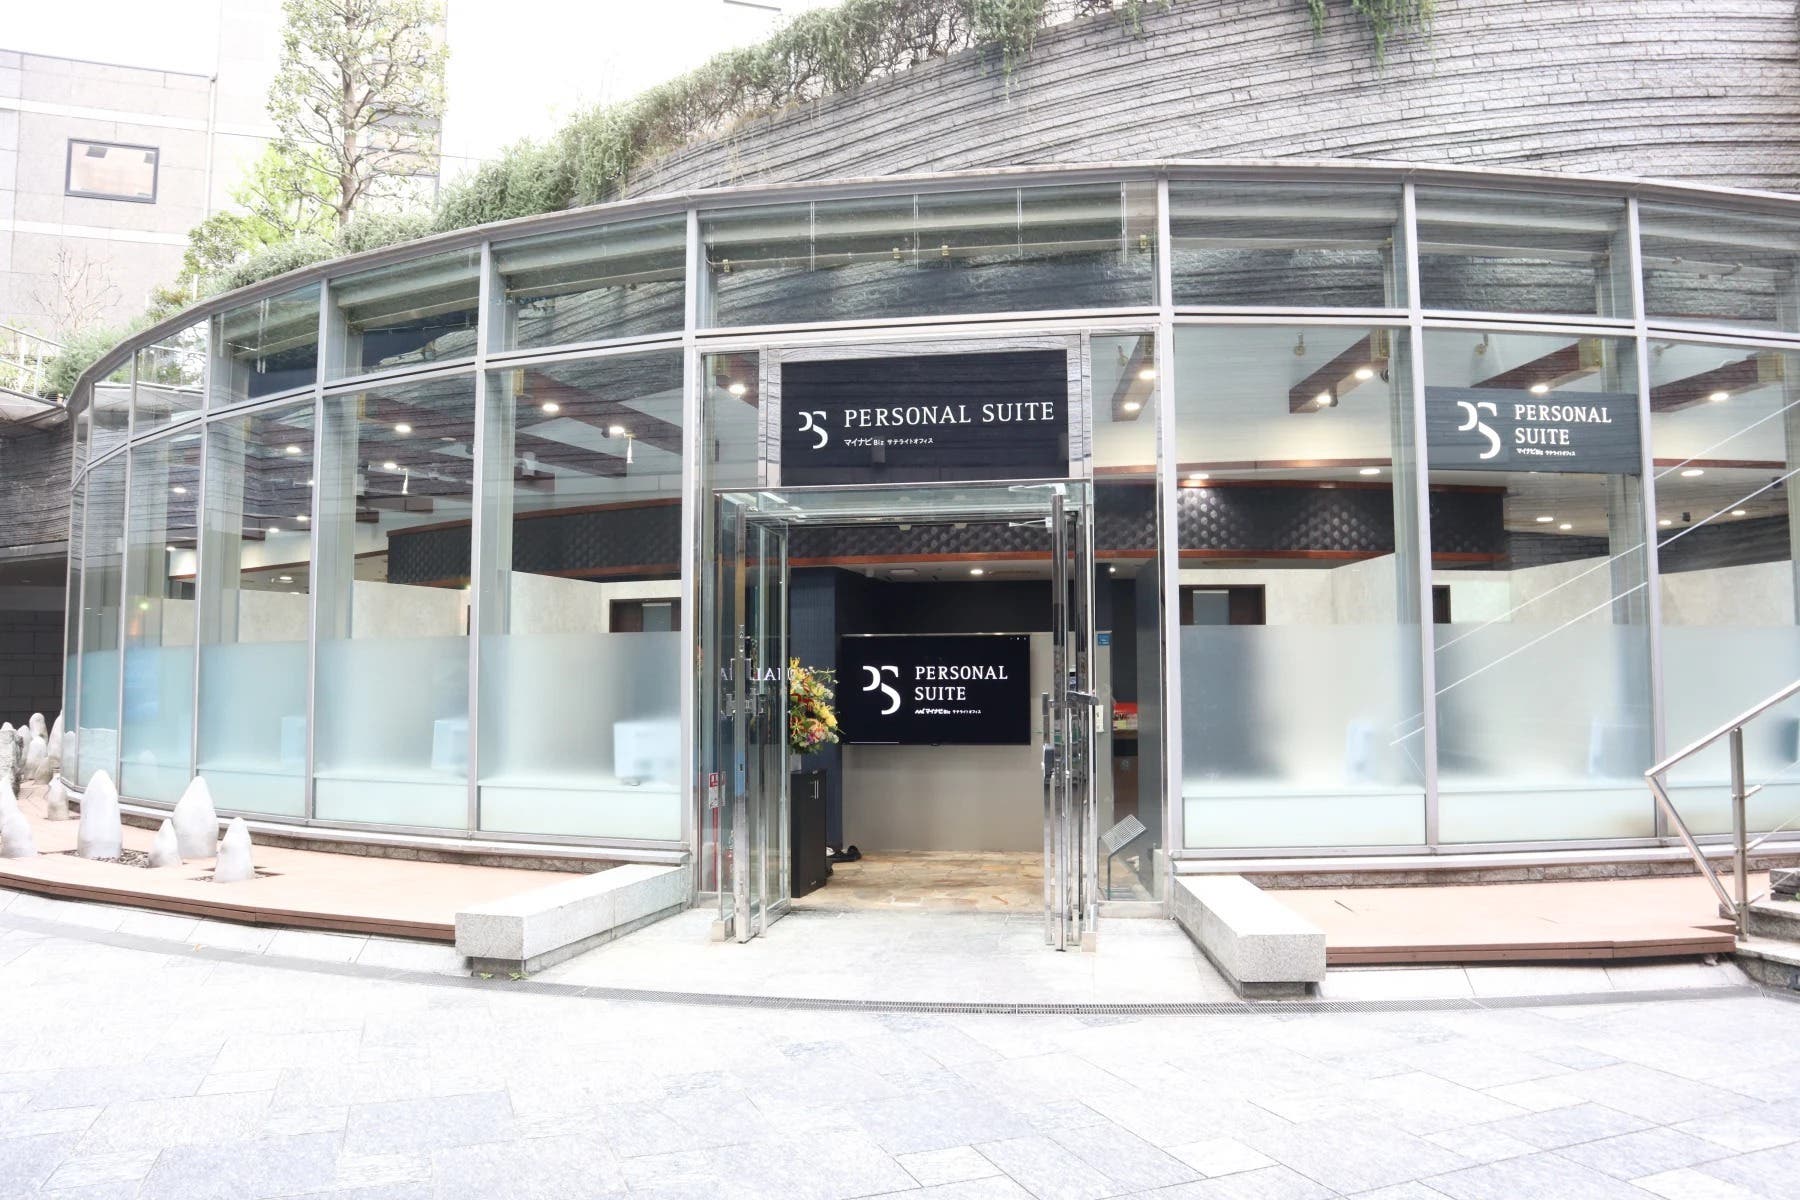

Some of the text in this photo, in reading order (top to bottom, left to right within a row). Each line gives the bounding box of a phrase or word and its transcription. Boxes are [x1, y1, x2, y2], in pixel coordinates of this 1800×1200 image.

[844, 401, 1054, 427] PERSONAL SUITE
[1514, 404, 1612, 423] PERSONAL
[1515, 427, 1570, 445] SUITE
[915, 665, 1008, 680] PERSONAL
[914, 686, 966, 701] SUITE
